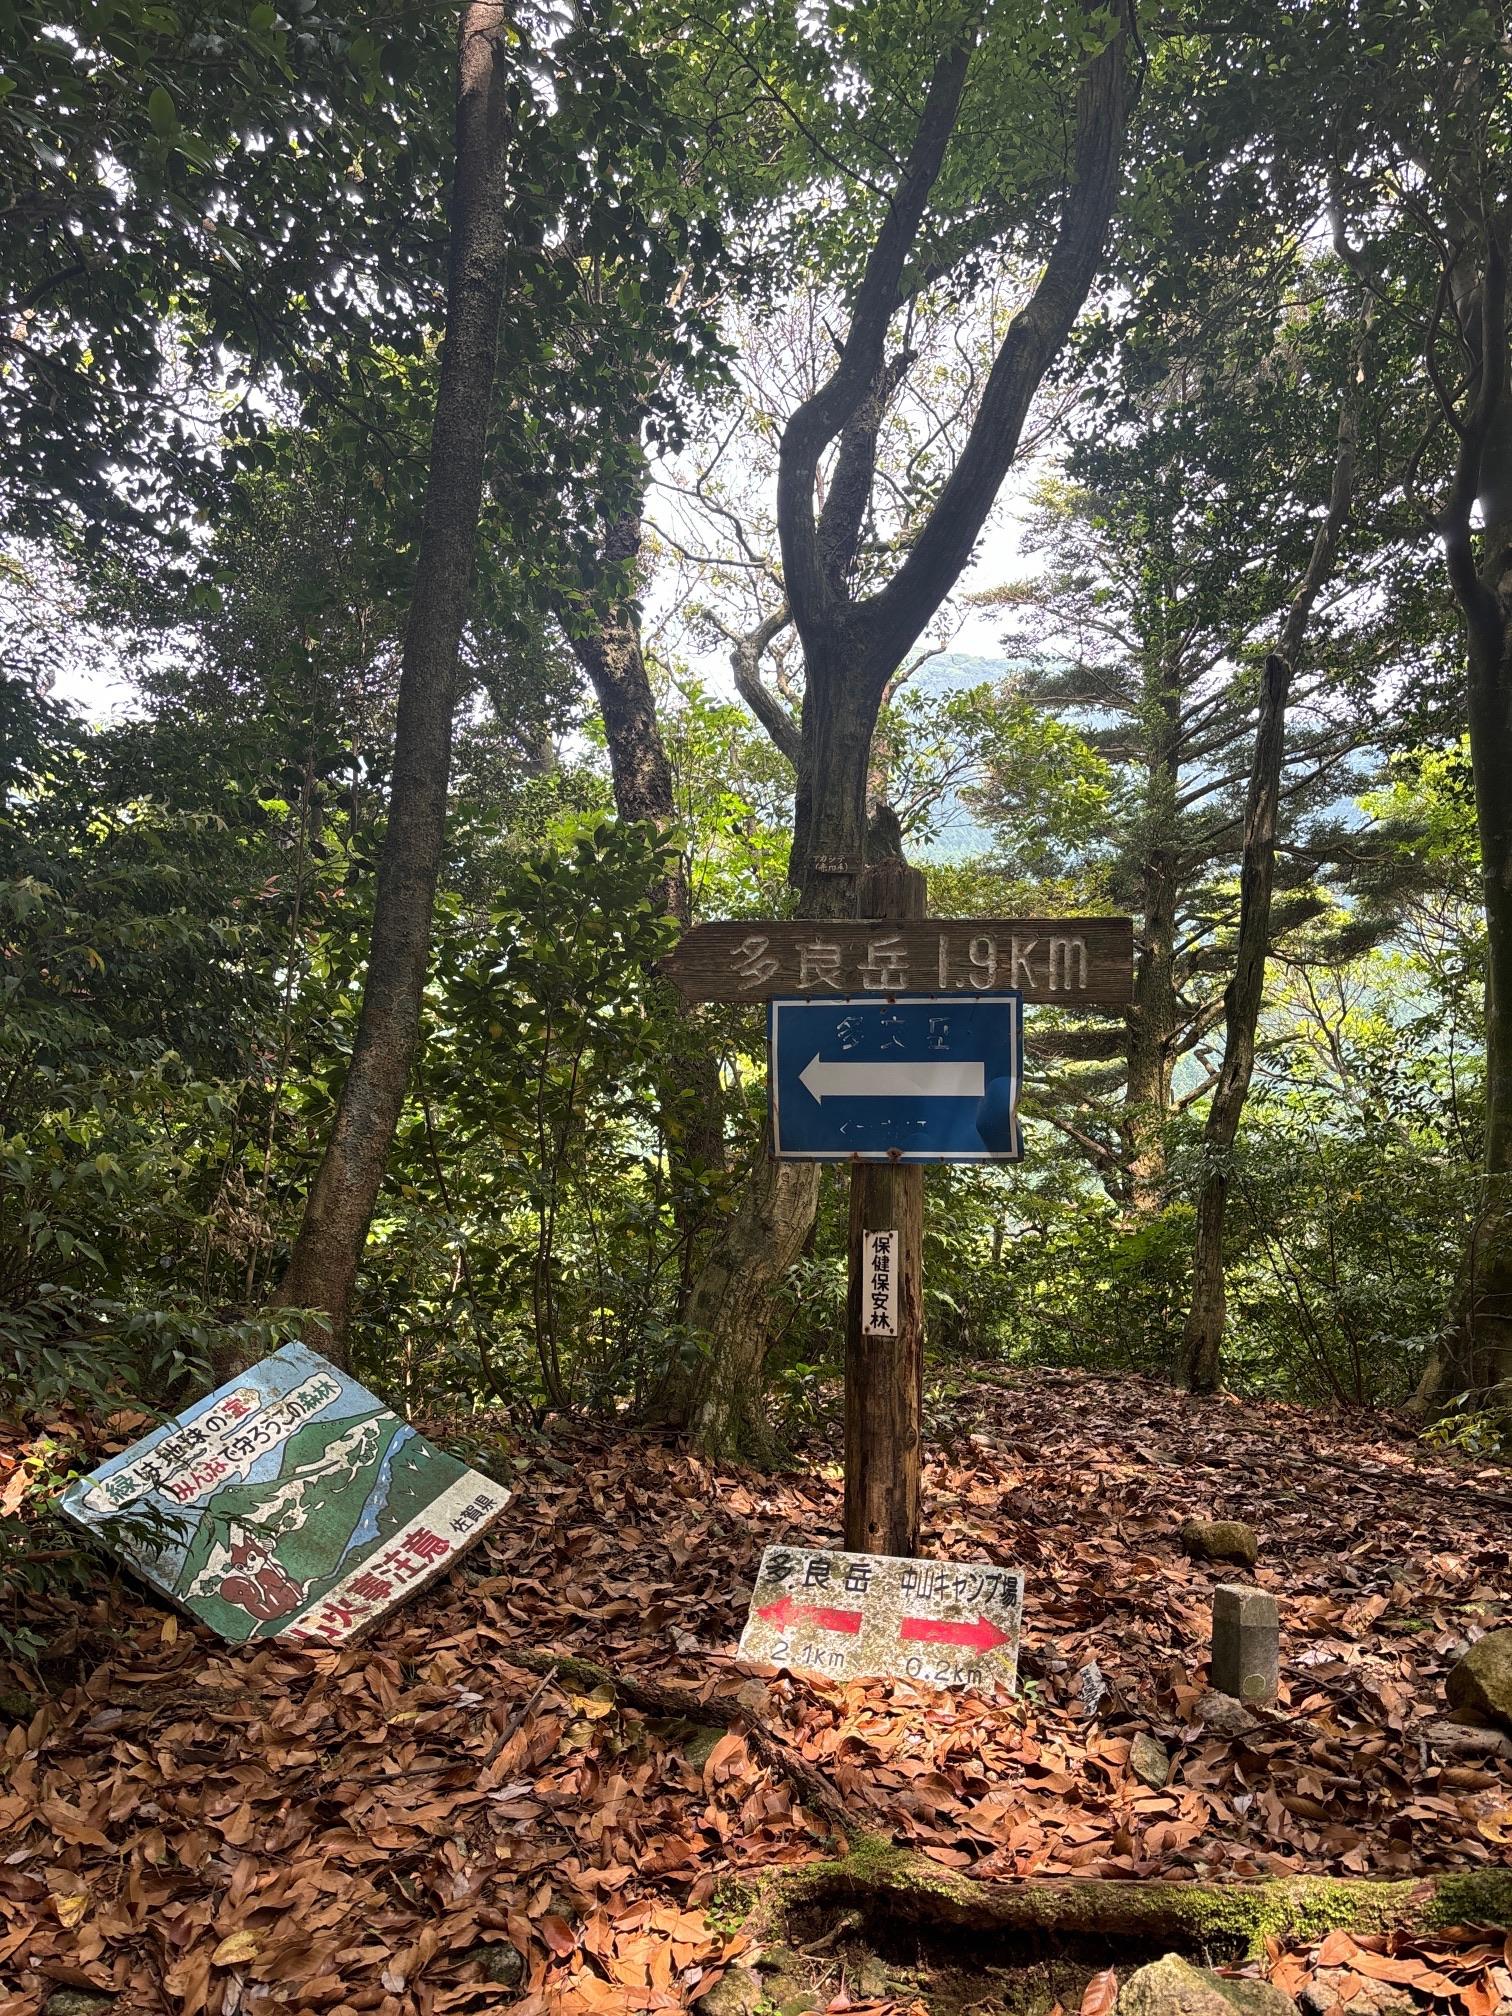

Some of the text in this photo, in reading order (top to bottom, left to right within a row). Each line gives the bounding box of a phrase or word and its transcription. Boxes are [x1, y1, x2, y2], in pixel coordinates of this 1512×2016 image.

[730, 935, 909, 990] 多良岳
[869, 1236, 891, 1330] 保健保安林
[105, 1397, 252, 1503] 緑は地球の宝
[172, 1379, 340, 1502] みんなで守ろうこの森林
[449, 1493, 499, 1535] 佐賀県
[765, 1552, 1019, 1608] 多良岳 中山キャンプ場
[905, 1656, 982, 1685] 0.2km
